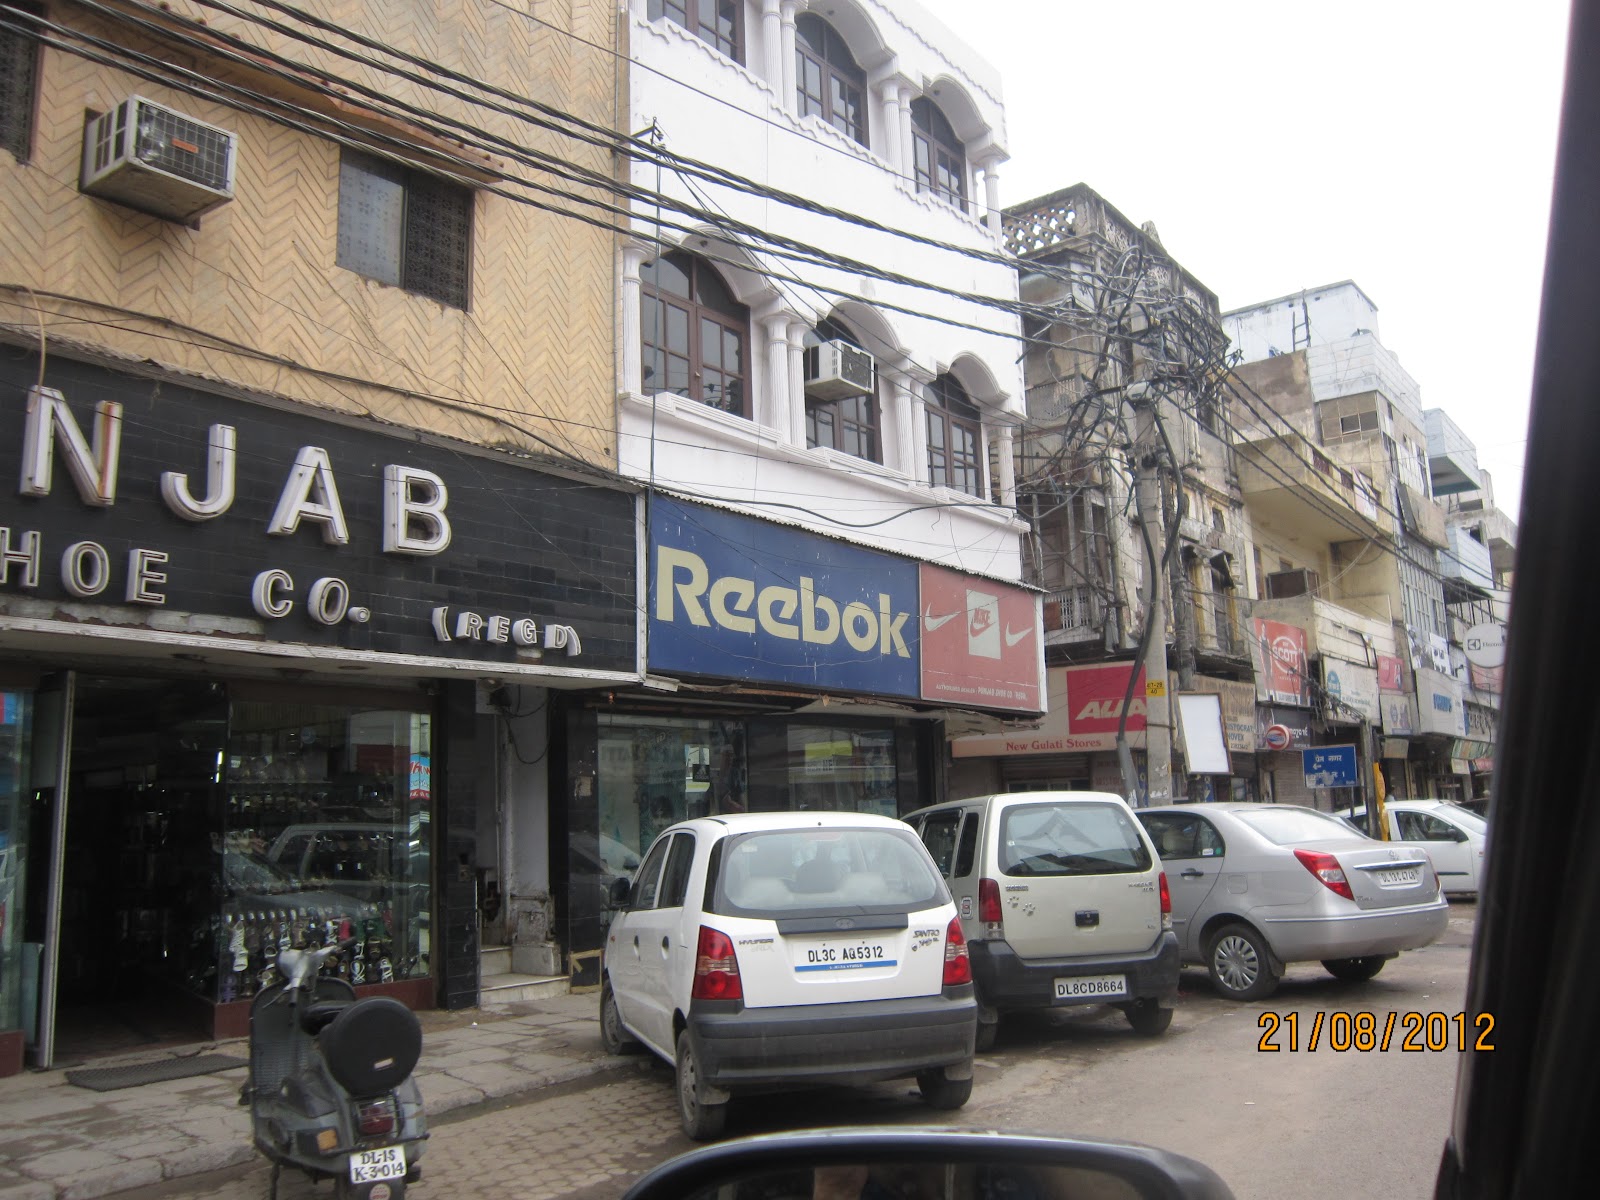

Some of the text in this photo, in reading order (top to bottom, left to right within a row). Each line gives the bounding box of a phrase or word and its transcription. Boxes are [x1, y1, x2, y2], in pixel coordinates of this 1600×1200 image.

[20, 385, 452, 556] NJAB
[252, 569, 371, 626] CO.
[657, 545, 911, 658] Reebok
[1006, 738, 1102, 751] New Gulati Stores
[1057, 980, 1123, 996] DL8CD8664
